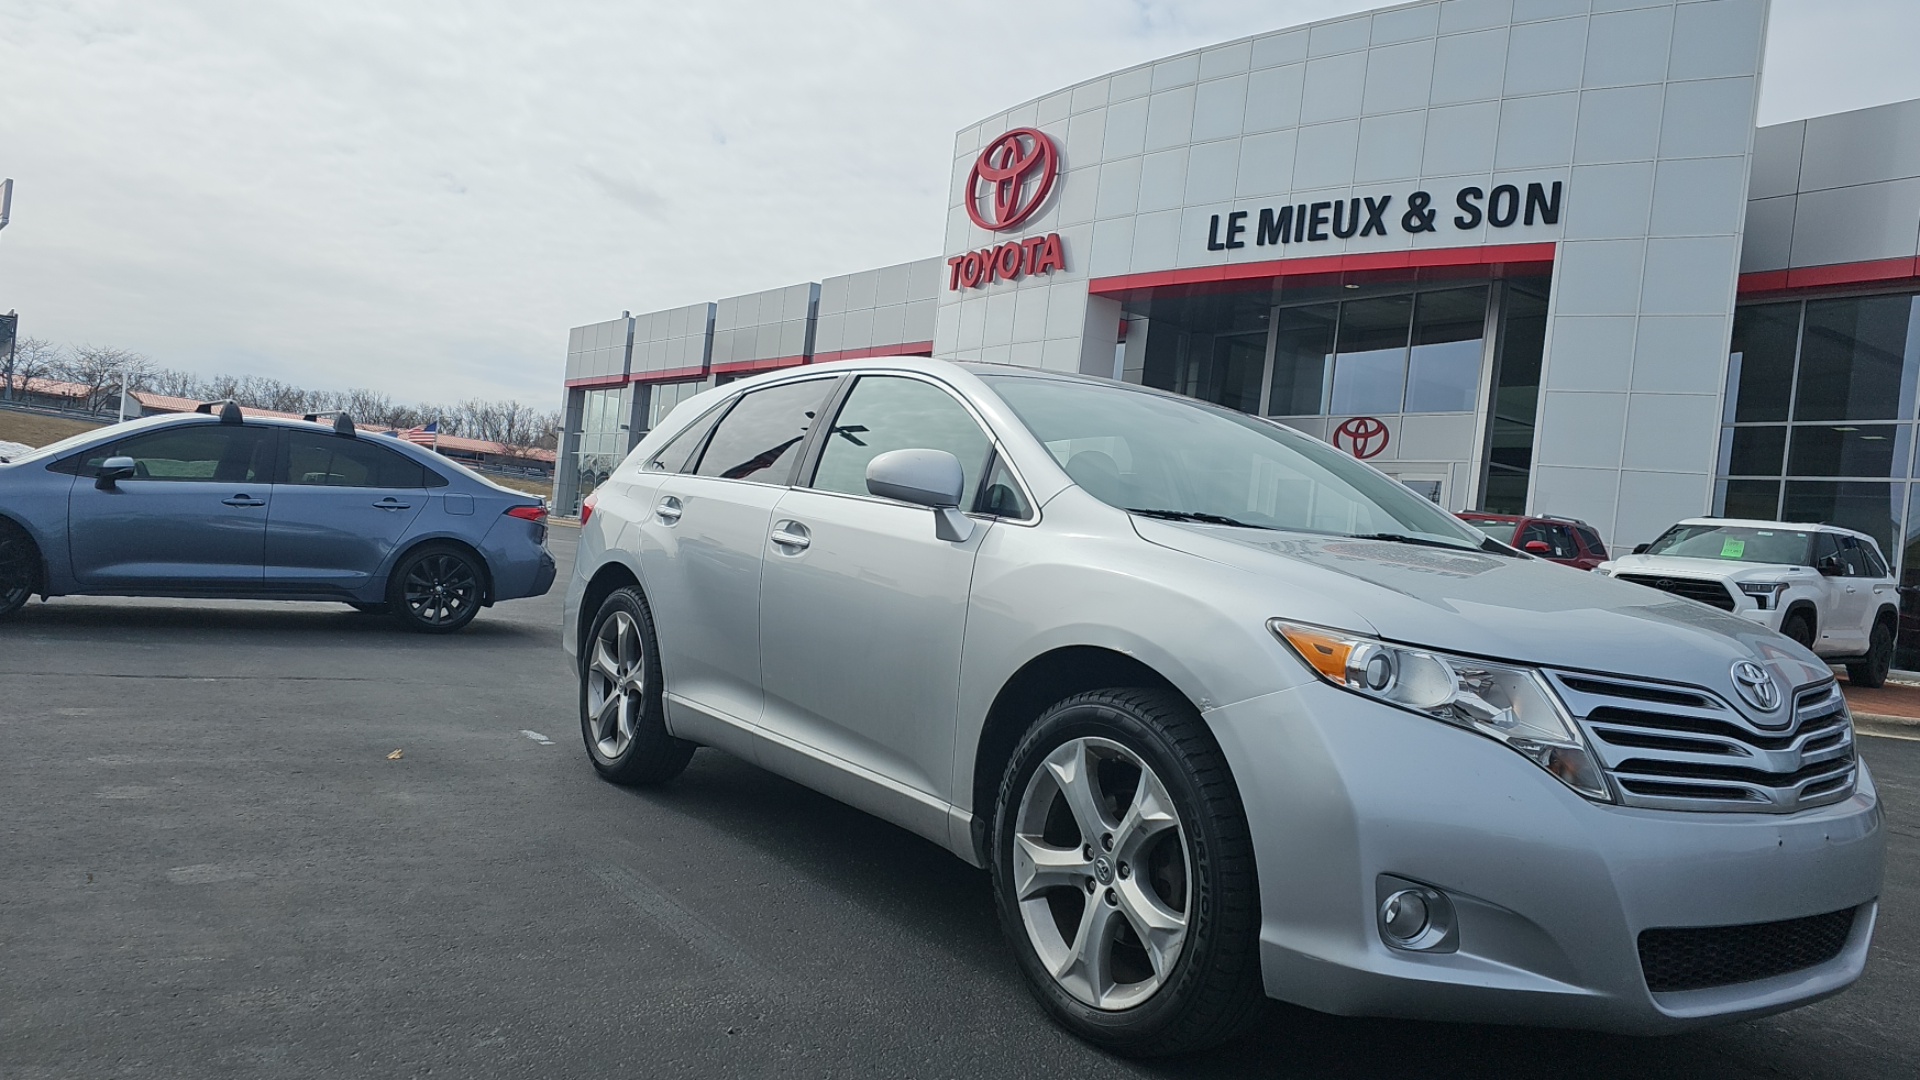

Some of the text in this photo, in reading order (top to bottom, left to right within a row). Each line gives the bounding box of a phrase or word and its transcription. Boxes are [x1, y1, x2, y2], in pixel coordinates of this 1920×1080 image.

[1208, 181, 1563, 251] LE MIEUX & SON
[948, 233, 1065, 291] TOYOTA
[1184, 793, 1211, 940] CORPION
